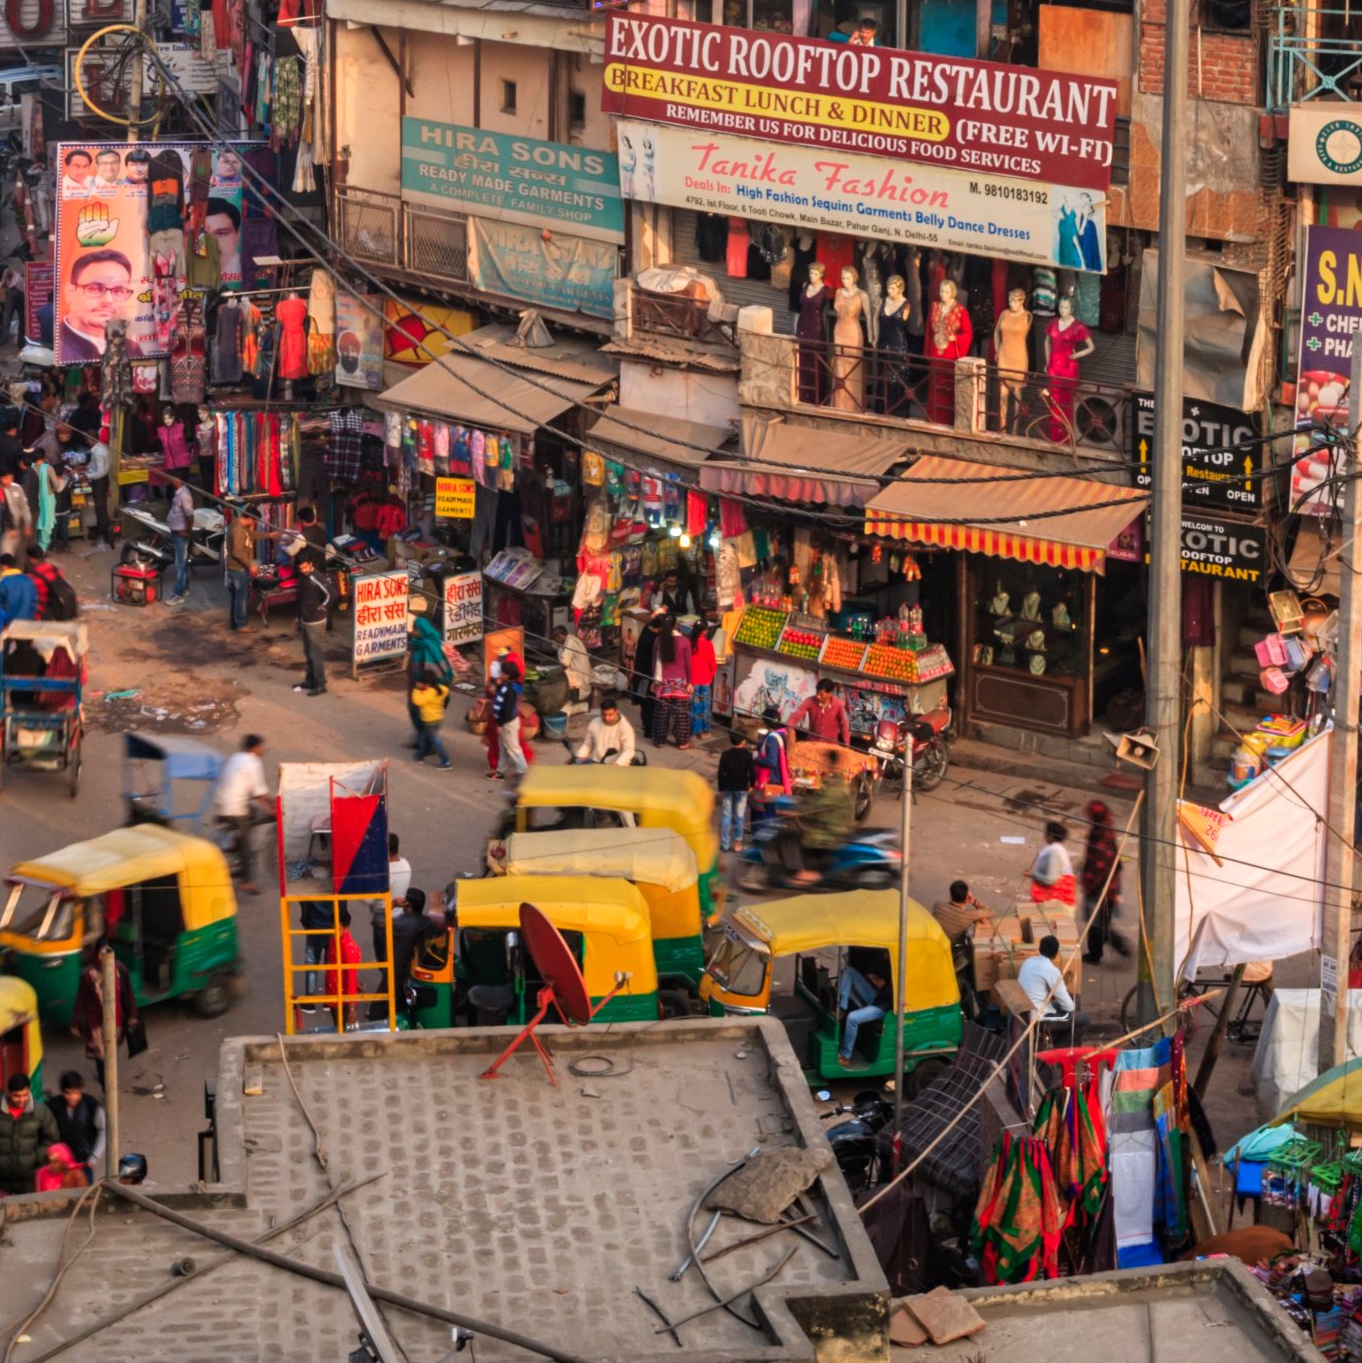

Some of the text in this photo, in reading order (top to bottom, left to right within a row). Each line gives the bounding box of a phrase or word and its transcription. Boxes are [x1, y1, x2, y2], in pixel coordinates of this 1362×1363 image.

[610, 16, 1117, 128] EXOTIC ROOFTOP RESTAURANT
[611, 68, 1029, 149] BREAKFAST LUNCH DINNER (FREE
[421, 125, 605, 175] HIRA SONS
[666, 103, 1042, 174] REMEMBER US FOR DELICIOUS FOOD SERVICES
[691, 142, 950, 209] Tanika Fashion
[419, 164, 605, 211] READY MADE GARMENTS
[969, 181, 983, 196] M.
[511, 199, 592, 222] FAMILY SHOP
[685, 175, 1031, 241] Deals High Fashion Garments Belly Dance Dresses
[685, 195, 938, 243] 4792, Floor, Tooti Main Bazar, Pahar Delhi-55
[1138, 397, 1155, 409] THE
[437, 482, 457, 493] HIRA
[1227, 489, 1256, 503] OPEN
[437, 495, 473, 505] READYMADE
[437, 506, 472, 515] GARMENTS
[1181, 520, 1225, 534] WELCOM TO
[357, 579, 382, 604] HIRA
[356, 623, 407, 641] READYMADE
[356, 637, 407, 656] GARMENTS
